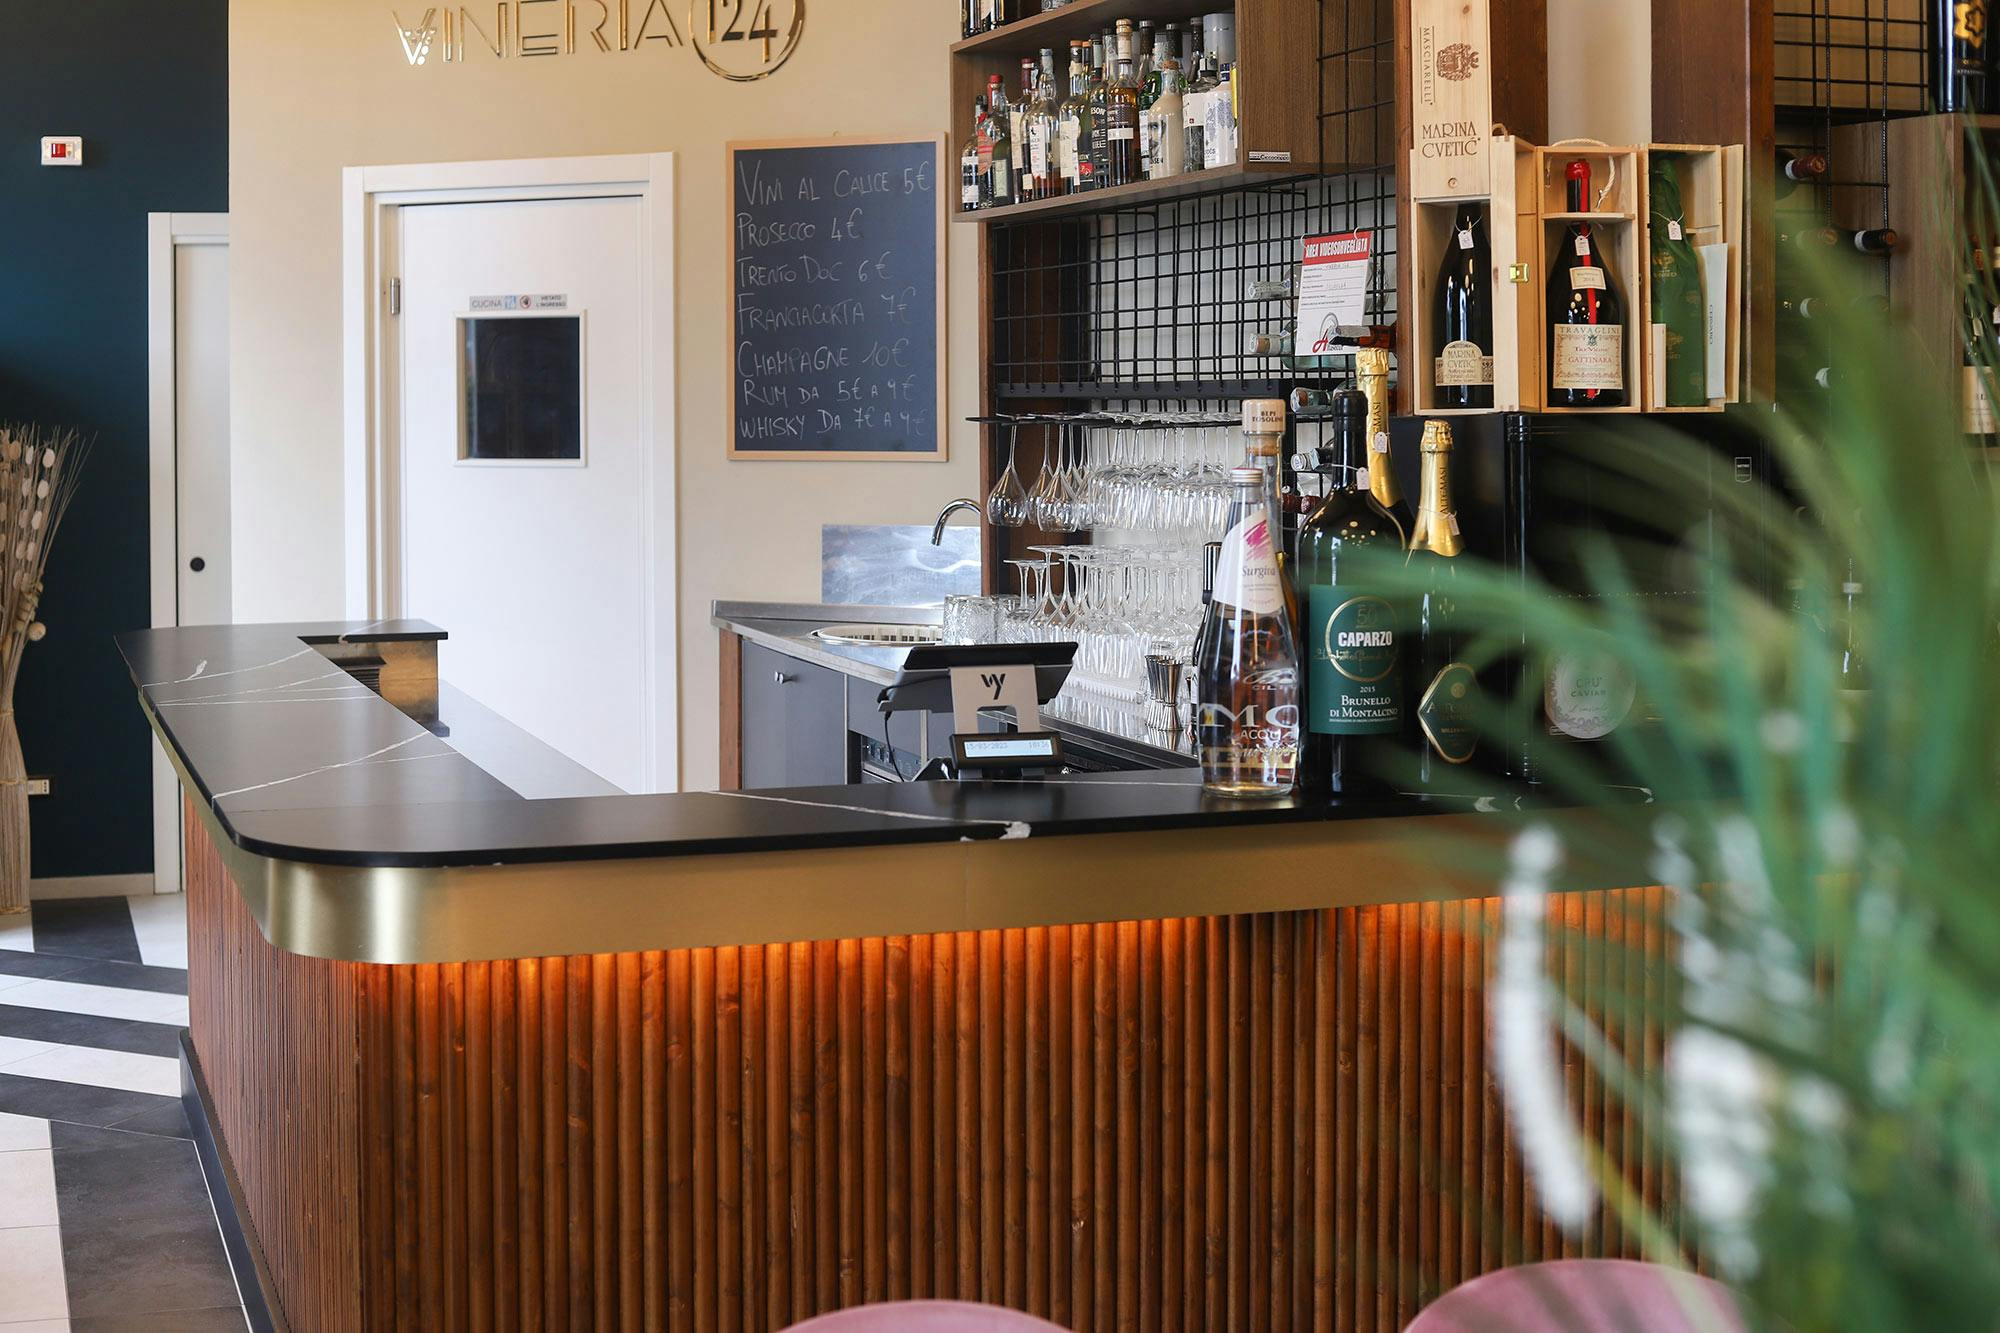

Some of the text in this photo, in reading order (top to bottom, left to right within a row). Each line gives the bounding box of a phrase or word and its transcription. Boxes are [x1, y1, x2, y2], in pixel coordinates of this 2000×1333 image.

[392, 0, 778, 65] VINERIA 124
[1422, 121, 1477, 139] MARINA
[799, 177, 820, 200] AL
[834, 170, 891, 198] CALICE
[736, 212, 816, 249] PROSECCO
[1305, 243, 1319, 258] AREA
[737, 257, 797, 287] TRENTO
[799, 255, 843, 283] DOC
[471, 300, 502, 308] CUCINA
[1560, 327, 1620, 335] TRAVAGLINI
[738, 341, 849, 378] CHAMPAGNE
[743, 379, 788, 408] RUM
[798, 387, 820, 404] DA
[739, 415, 805, 440] WHISKY
[817, 409, 842, 434] DA
[1338, 631, 1393, 647] CAPARZO
[1330, 706, 1399, 718] DI MONTALCINO
[1341, 695, 1391, 706] BRUNELLO
